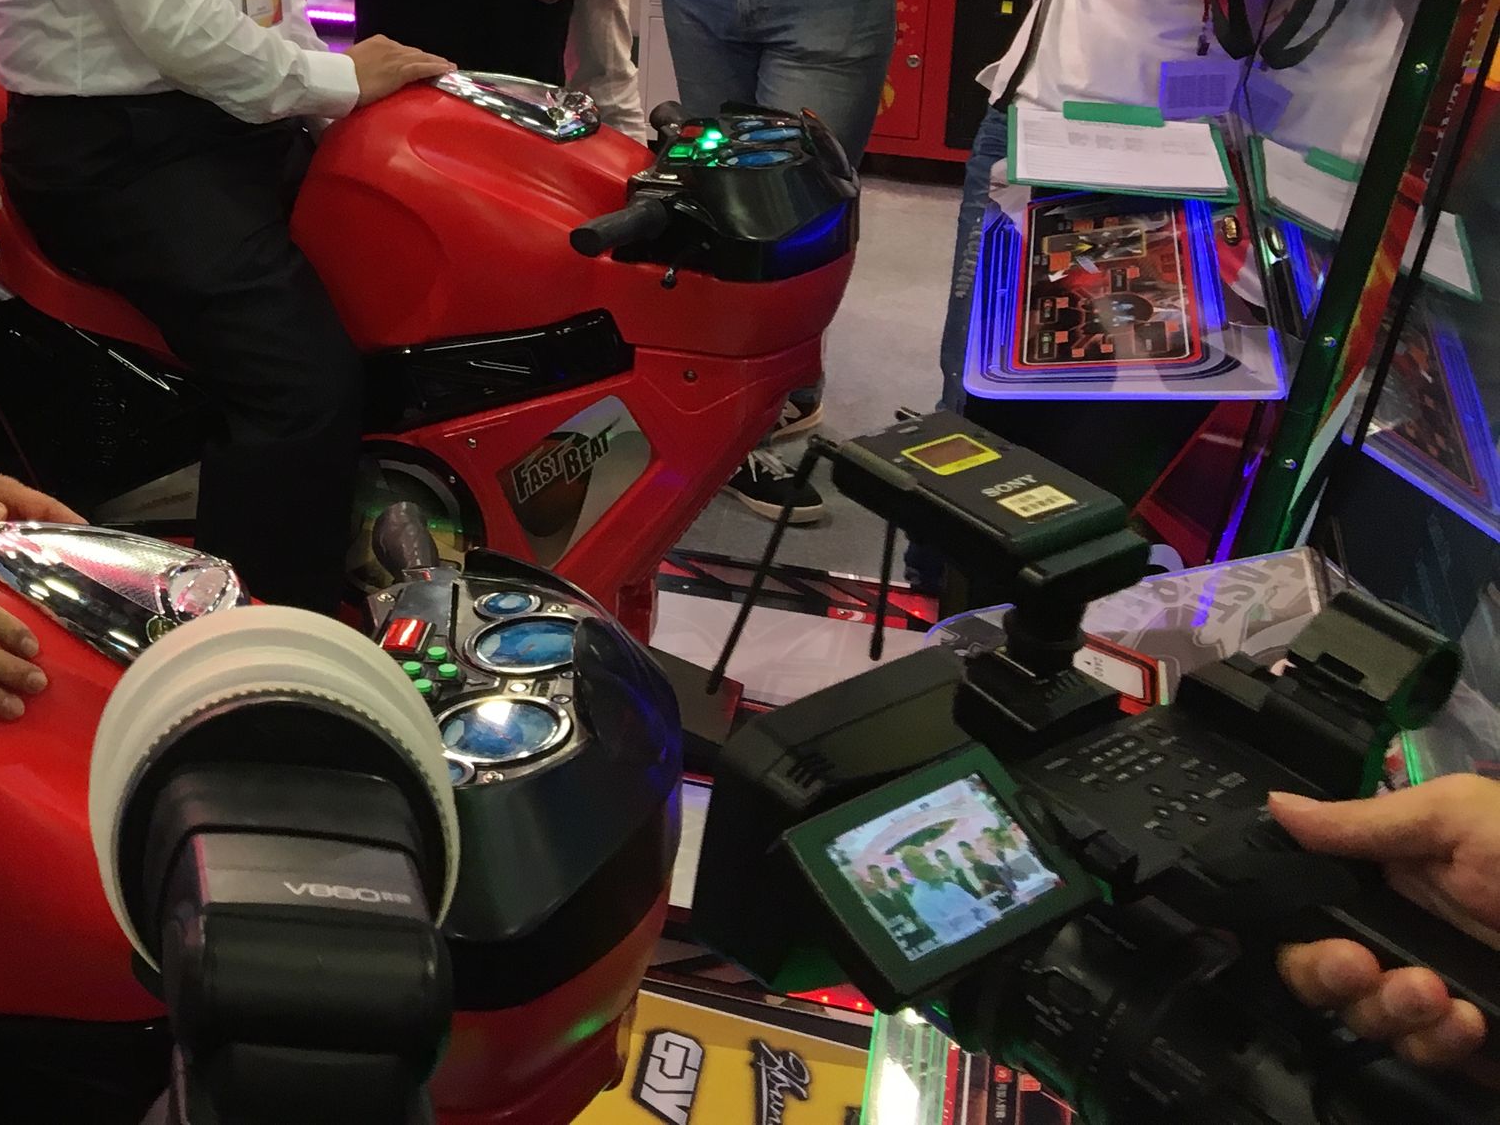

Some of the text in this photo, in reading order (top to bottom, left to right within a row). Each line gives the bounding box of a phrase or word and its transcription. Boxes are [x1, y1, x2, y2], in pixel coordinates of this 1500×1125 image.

[511, 425, 614, 504] FAST BEAT
[981, 474, 1039, 498] SONY
